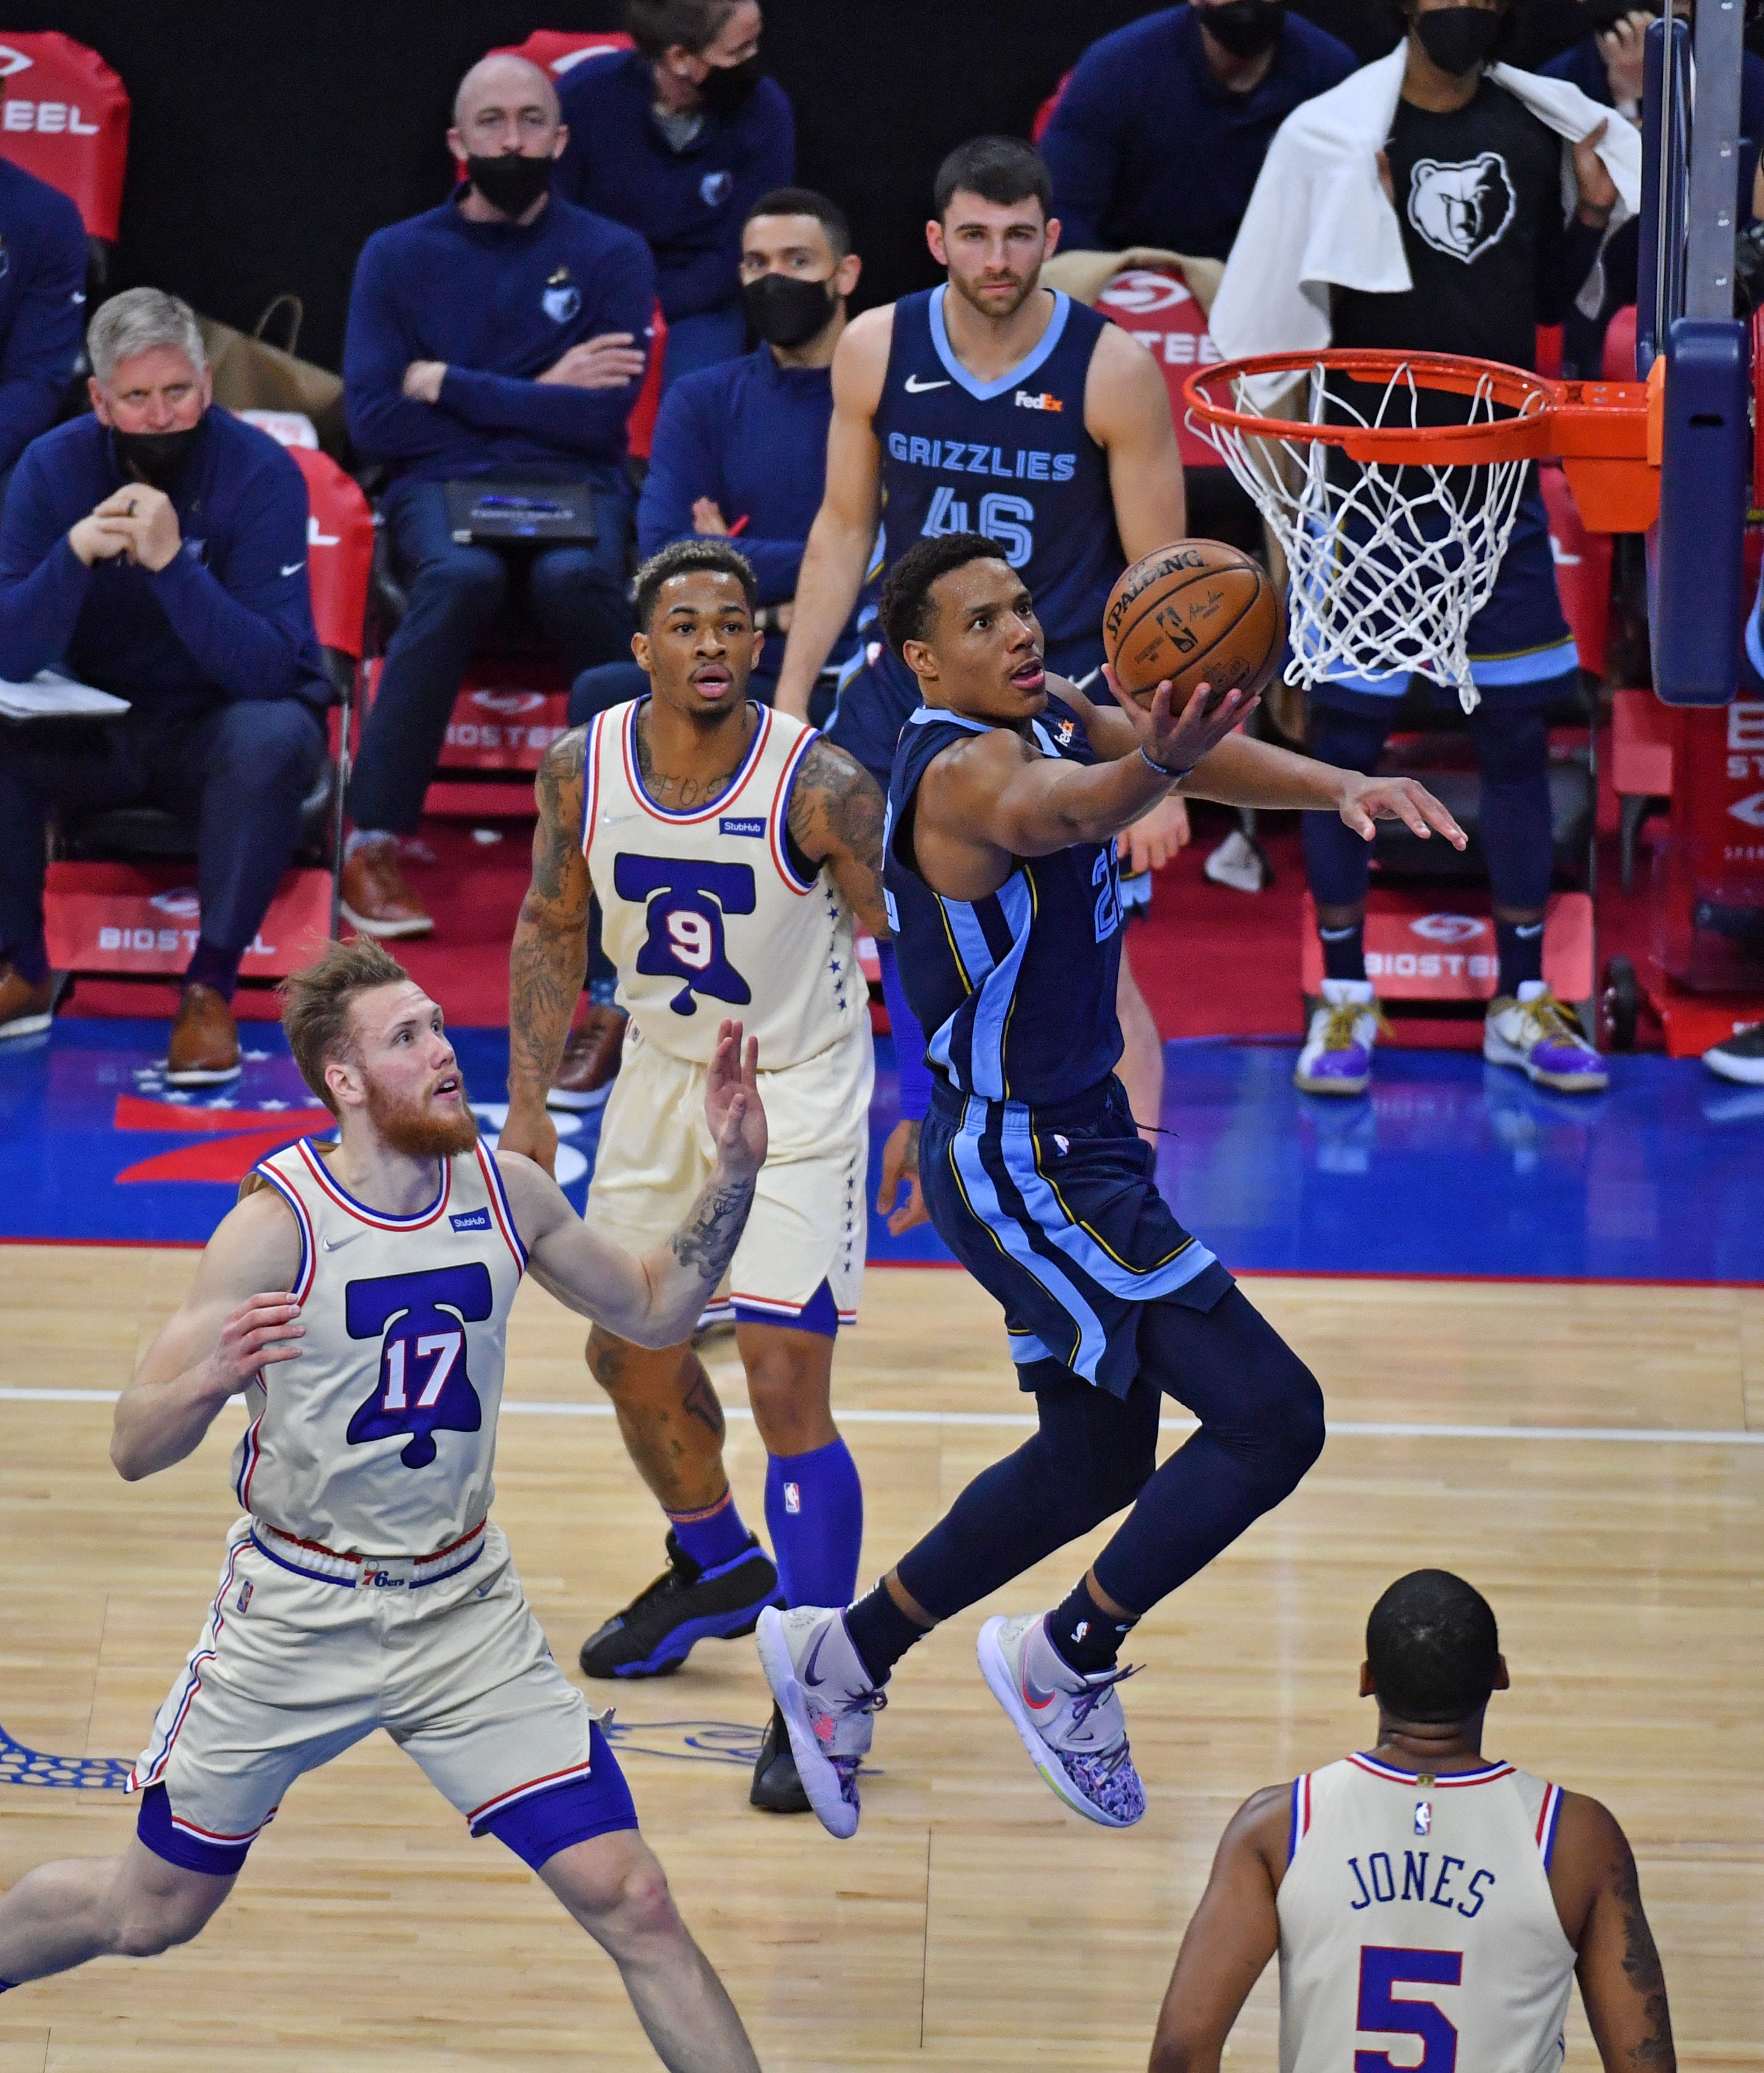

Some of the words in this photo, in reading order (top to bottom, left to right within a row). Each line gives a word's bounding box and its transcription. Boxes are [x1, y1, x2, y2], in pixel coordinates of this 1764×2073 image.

[1015, 390, 1064, 412] FedEx
[888, 432, 1077, 481] GRIZZLIES
[921, 486, 1034, 569] 46
[1106, 549, 1205, 641] SPALDING
[1054, 719, 1075, 747] FedEx
[725, 821, 760, 832] StubHub
[99, 927, 277, 955] BIOSTL
[666, 910, 713, 970] 9
[1364, 952, 1499, 979] BIOSTE
[455, 1217, 486, 1228] StubHub
[383, 1329, 464, 1412] 17
[362, 1569, 405, 1587] 76ers
[1347, 1850, 1496, 1919] JONES
[1354, 1945, 1464, 2073] 5
